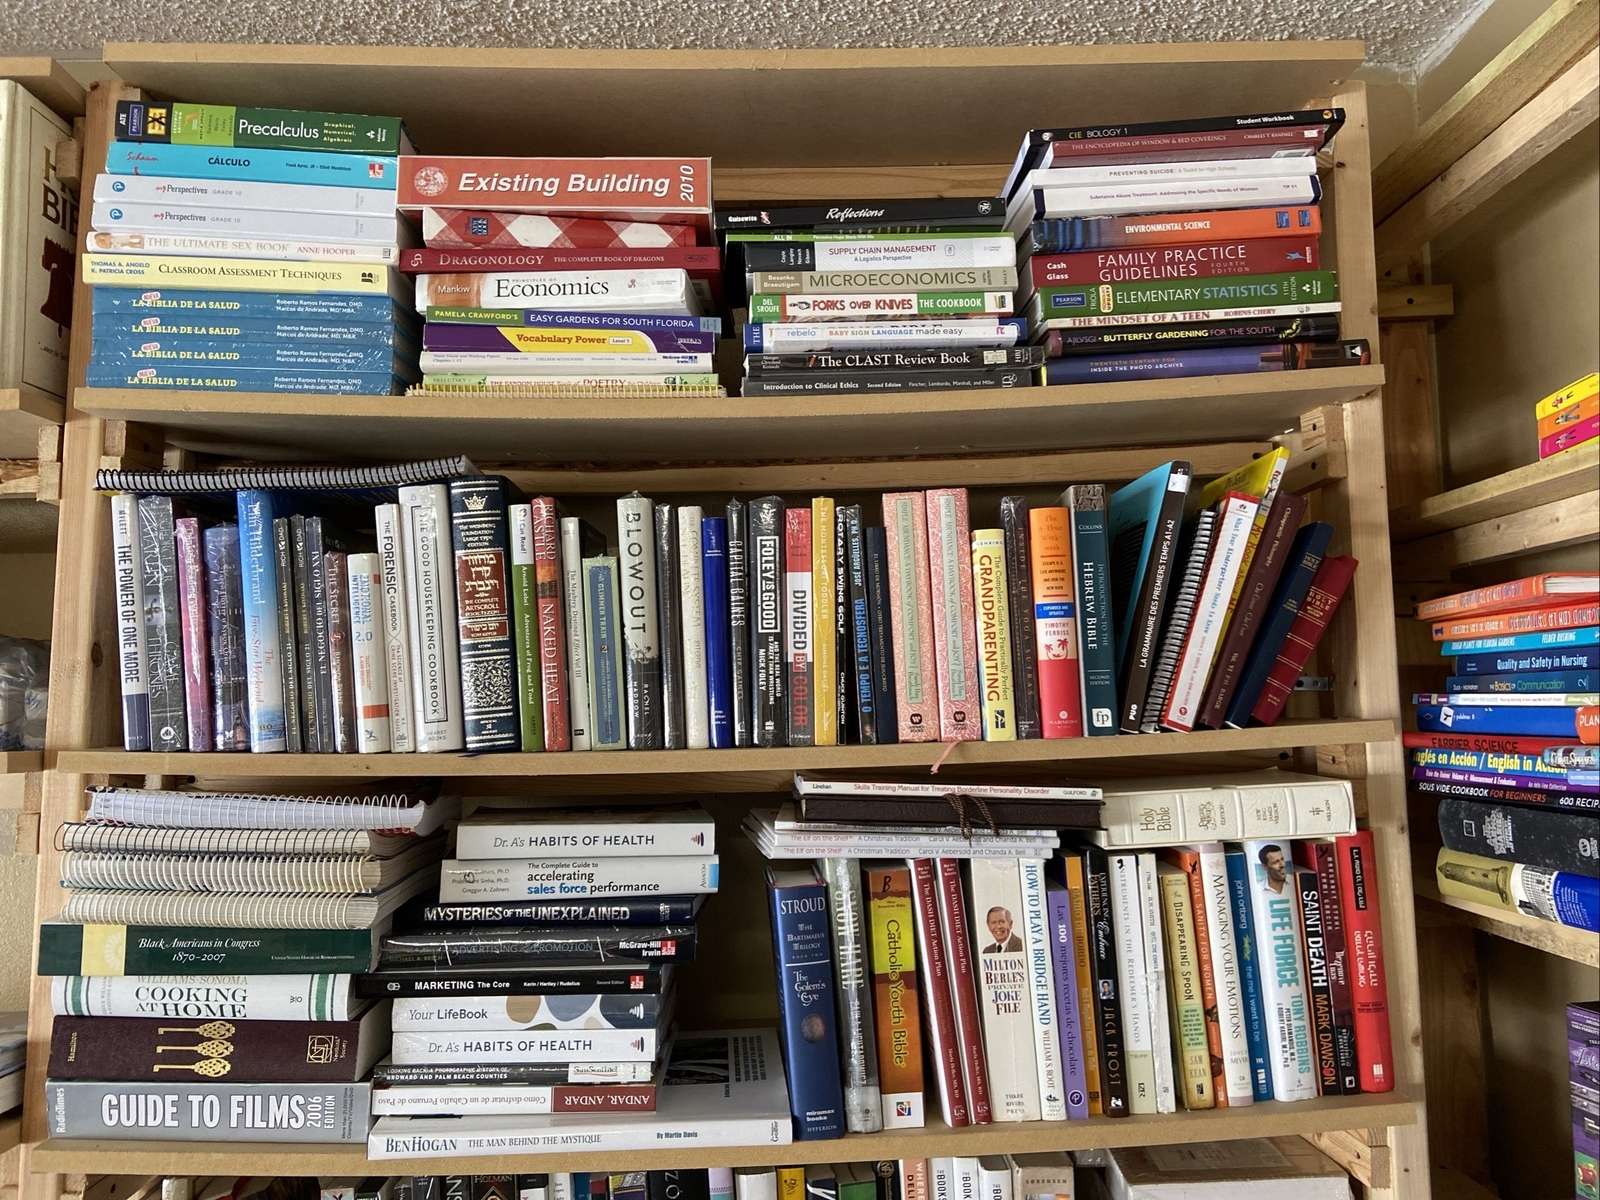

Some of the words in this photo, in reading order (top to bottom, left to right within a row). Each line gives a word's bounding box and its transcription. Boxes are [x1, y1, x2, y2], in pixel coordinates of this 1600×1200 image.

[1237, 117, 1261, 125] Student
[1263, 114, 1294, 123] Workbook
[239, 119, 319, 139] Precalculus
[208, 155, 250, 167] CÁLCULO
[458, 173, 560, 197] Existing
[566, 172, 670, 197] Building
[680, 165, 694, 202] 2010
[826, 208, 885, 220] Reflections
[1125, 222, 1182, 234] ENVIRONMENTAL
[1184, 220, 1210, 230] SCIENCE
[148, 238, 170, 247] THE
[174, 239, 228, 249] ULTIMATE
[232, 241, 252, 251] SEX
[256, 242, 290, 252] BOOK
[297, 246, 320, 254] ANNE
[323, 247, 356, 255] HOOPER
[829, 247, 856, 256] SUPPLY
[859, 247, 881, 255] CHAIN
[883, 245, 936, 254] MANAGEMENT
[439, 254, 544, 266] DRAGONOLOGY
[1098, 253, 1155, 268] FAMILY
[1165, 245, 1246, 262] PRACTICE
[158, 264, 216, 275] CLASSROOM
[218, 266, 277, 277] ASSESSMENT
[279, 268, 342, 280] TECHNIQUES
[1047, 262, 1066, 270] Cash
[1100, 264, 1197, 282] GUIDELINES
[809, 272, 976, 287] MICROECONOMICS
[1047, 272, 1068, 280] Glass
[438, 284, 471, 294] Mankiw
[495, 276, 609, 298] Economics
[1117, 288, 1200, 304] ELEMENTARY
[1203, 283, 1278, 299] STATISTICS
[132, 300, 144, 308] LA
[147, 300, 177, 308] BIBLIA
[195, 301, 207, 309] LA
[813, 299, 845, 311] FORKS
[850, 300, 871, 309] OVER
[875, 299, 913, 310] KNIVES
[919, 299, 934, 307] THE
[936, 298, 982, 307] COOKBOOK
[468, 312, 518, 320] CRAWFORD'S
[530, 314, 553, 322] EASY
[555, 316, 600, 325] GARDENS
[602, 317, 621, 326] FOR
[623, 318, 653, 326] SOUTH
[656, 319, 694, 327] FLORIDA
[516, 334, 573, 345] Vocabulary
[575, 334, 606, 344] Power
[787, 329, 816, 337] rebelo
[916, 328, 940, 336] made
[942, 328, 963, 337] easy
[1104, 332, 1152, 342] BUTTERFLY
[1155, 329, 1208, 339] GARDENING
[818, 356, 841, 367] The
[845, 355, 891, 367] CLAST
[895, 354, 937, 365] Review
[940, 353, 970, 363] Book
[118, 545, 131, 564] THE
[421, 536, 430, 569] GOOD
[762, 541, 774, 578] FOLEY
[383, 536, 397, 594] FORENSIC
[626, 512, 646, 635] BLOWOUT
[119, 567, 135, 609] POWER
[766, 579, 774, 590] IS
[1083, 562, 1095, 613] HEBREW
[122, 612, 136, 624] OF
[423, 572, 434, 650] HOUSEKEEPING
[762, 591, 775, 628] GOOD
[792, 590, 807, 651] DIVIDED
[837, 605, 845, 634] GOLF
[980, 555, 1000, 701] GRANDPARENTING
[122, 627, 137, 649] ONE
[543, 603, 558, 659] NAKED
[1087, 618, 1097, 649] BIBLE
[124, 652, 139, 683] MORE
[794, 654, 807, 670] BY
[1497, 659, 1517, 670] Quality
[1518, 658, 1530, 669] and
[1531, 656, 1552, 669] Safety
[1553, 656, 1560, 666] in
[1561, 654, 1588, 667] Nursing
[428, 653, 440, 715] COOKBOOK
[545, 661, 559, 705] HEAT
[793, 676, 808, 726] COLOR
[1129, 704, 1137, 721] PUG
[493, 837, 508, 848] Dr.
[510, 837, 525, 848] A's
[529, 836, 578, 846] HABITS
[582, 836, 600, 846] OF
[603, 835, 655, 845] HEALTH
[527, 870, 595, 882] accelerating
[527, 884, 556, 895] sales
[559, 883, 587, 894] force
[590, 881, 659, 895] performance
[424, 907, 502, 921] MYSTERIES
[504, 910, 514, 918] OF
[515, 909, 531, 917] THE
[532, 906, 630, 921] UNEXPLAINED
[781, 897, 825, 914] STROUD
[1212, 874, 1231, 941] MANAGING
[1303, 890, 1321, 936] SAINT
[1269, 899, 1293, 932] LIFE
[138, 938, 165, 949] Black
[168, 939, 214, 949] Americans
[215, 939, 222, 947] in
[225, 939, 260, 950] Congress
[887, 919, 903, 981] Catholic
[984, 959, 1023, 971] MILTON
[1221, 942, 1235, 978] YOUR
[1274, 935, 1299, 988] FORCE
[1308, 938, 1327, 987] DEATH
[415, 980, 474, 990] MARKETING
[985, 971, 1025, 984] BERLE'S
[135, 987, 248, 1002] COOKING
[992, 991, 1021, 1004] JOKE
[136, 1003, 158, 1013] AT
[161, 1003, 247, 1018] HOME
[890, 982, 905, 1025] Youth
[995, 1002, 1021, 1015] FILE
[1225, 980, 1242, 1039] EMOTIONS
[1316, 994, 1330, 1029] MARK
[1320, 1034, 1336, 1086] DAWSON
[102, 1094, 179, 1128] GUIDE
[187, 1095, 221, 1128] TO
[230, 1094, 306, 1129] FILMS
